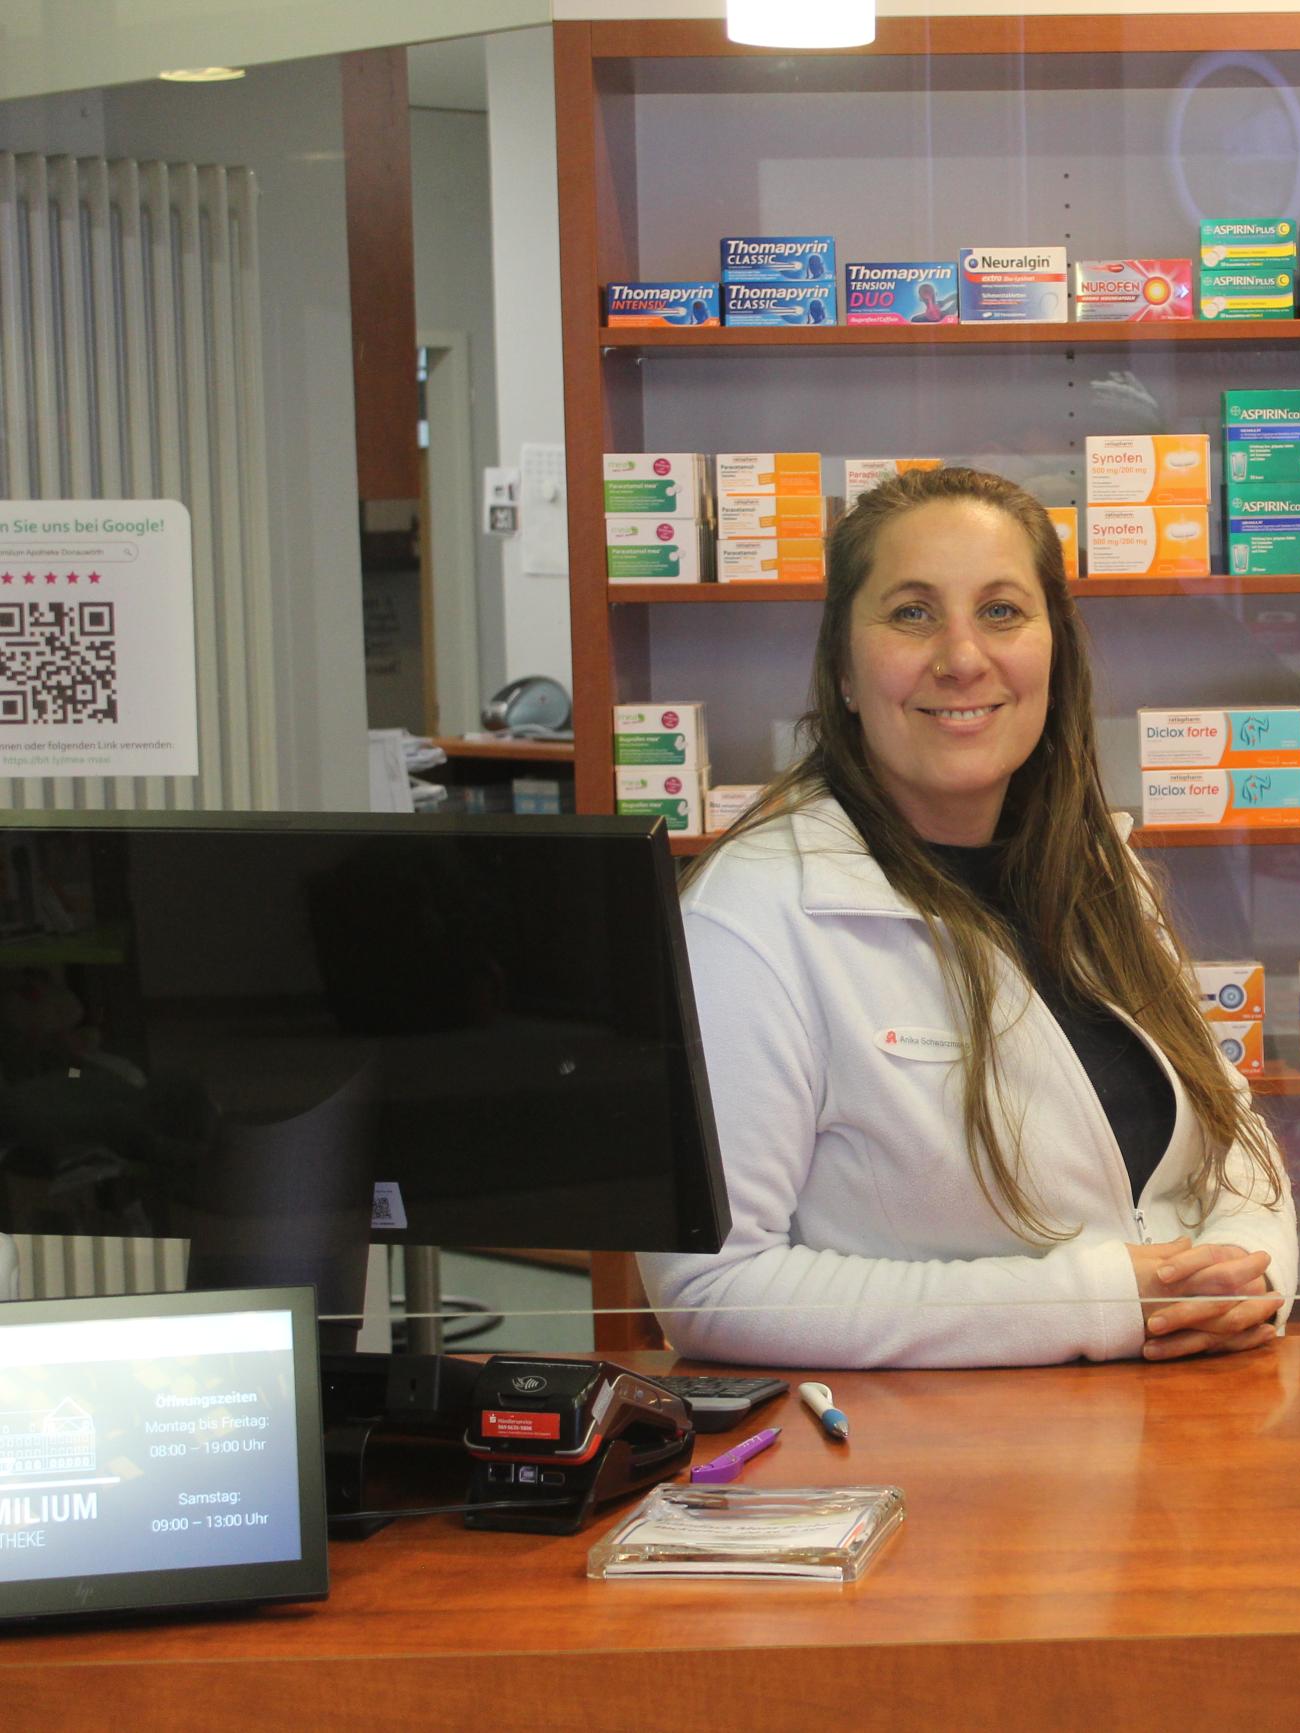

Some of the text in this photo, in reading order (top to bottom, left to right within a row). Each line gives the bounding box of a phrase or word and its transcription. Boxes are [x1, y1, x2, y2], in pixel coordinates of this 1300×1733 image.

[1214, 225, 1255, 234] ASPIRIN
[727, 240, 828, 256] Thomapyrin
[727, 255, 777, 265] CLASSIC
[981, 256, 1050, 272] Neuralgin
[849, 265, 951, 282] Thomapyrin
[851, 282, 895, 290] TENSION
[1081, 281, 1140, 293] NUROFEN
[1213, 276, 1255, 286] ASPIRIN
[612, 286, 713, 302] Thomapyrin
[729, 285, 829, 301] Thomapyrin
[851, 292, 895, 307] DUO
[612, 300, 667, 310] INTENSIV
[729, 300, 777, 310] CLASSIC
[1240, 408, 1287, 420] ASPIRIN
[1091, 452, 1143, 466] Synofen
[1242, 501, 1289, 512] ASPIRIN
[14, 519, 164, 536] Sie uns bei Google!
[1093, 524, 1144, 537] Synofen
[1147, 726, 1217, 740] Diclox forte
[1149, 783, 1219, 797] Diclox forte
[155, 1391, 257, 1409] Öffnungszeiten
[145, 1415, 270, 1434] Montag bis Freitag:
[150, 1439, 266, 1458] 08:00 19:00 Uhr
[178, 1491, 241, 1507] Samstag:
[152, 1513, 269, 1532] 09:00 13:00 Uhr
